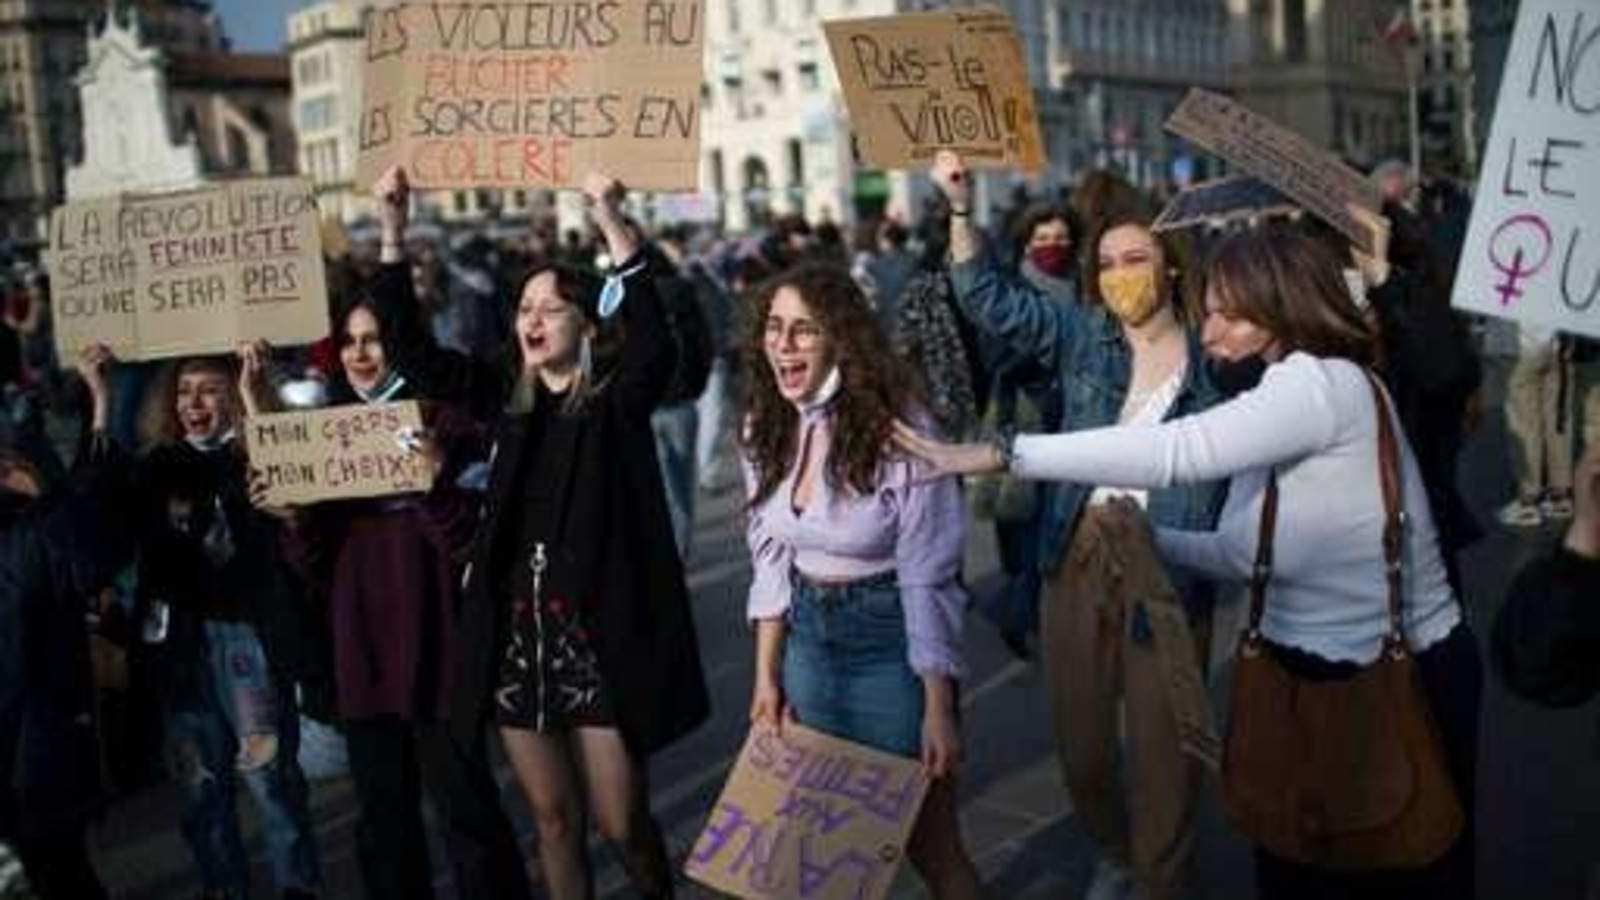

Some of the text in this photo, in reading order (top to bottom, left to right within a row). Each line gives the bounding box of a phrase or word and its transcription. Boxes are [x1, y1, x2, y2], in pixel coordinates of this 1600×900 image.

[430, 2, 620, 50] VIOLEURS
[645, 2, 697, 45] AU
[412, 95, 622, 138] SORCIERES
[634, 97, 696, 138] EN
[1503, 137, 1584, 198] LE
[57, 209, 101, 250] LA
[58, 252, 136, 290] SERA
[102, 290, 135, 314] NE
[148, 274, 226, 313] SERA
[242, 262, 297, 295] PAS
[266, 461, 316, 488] MON
